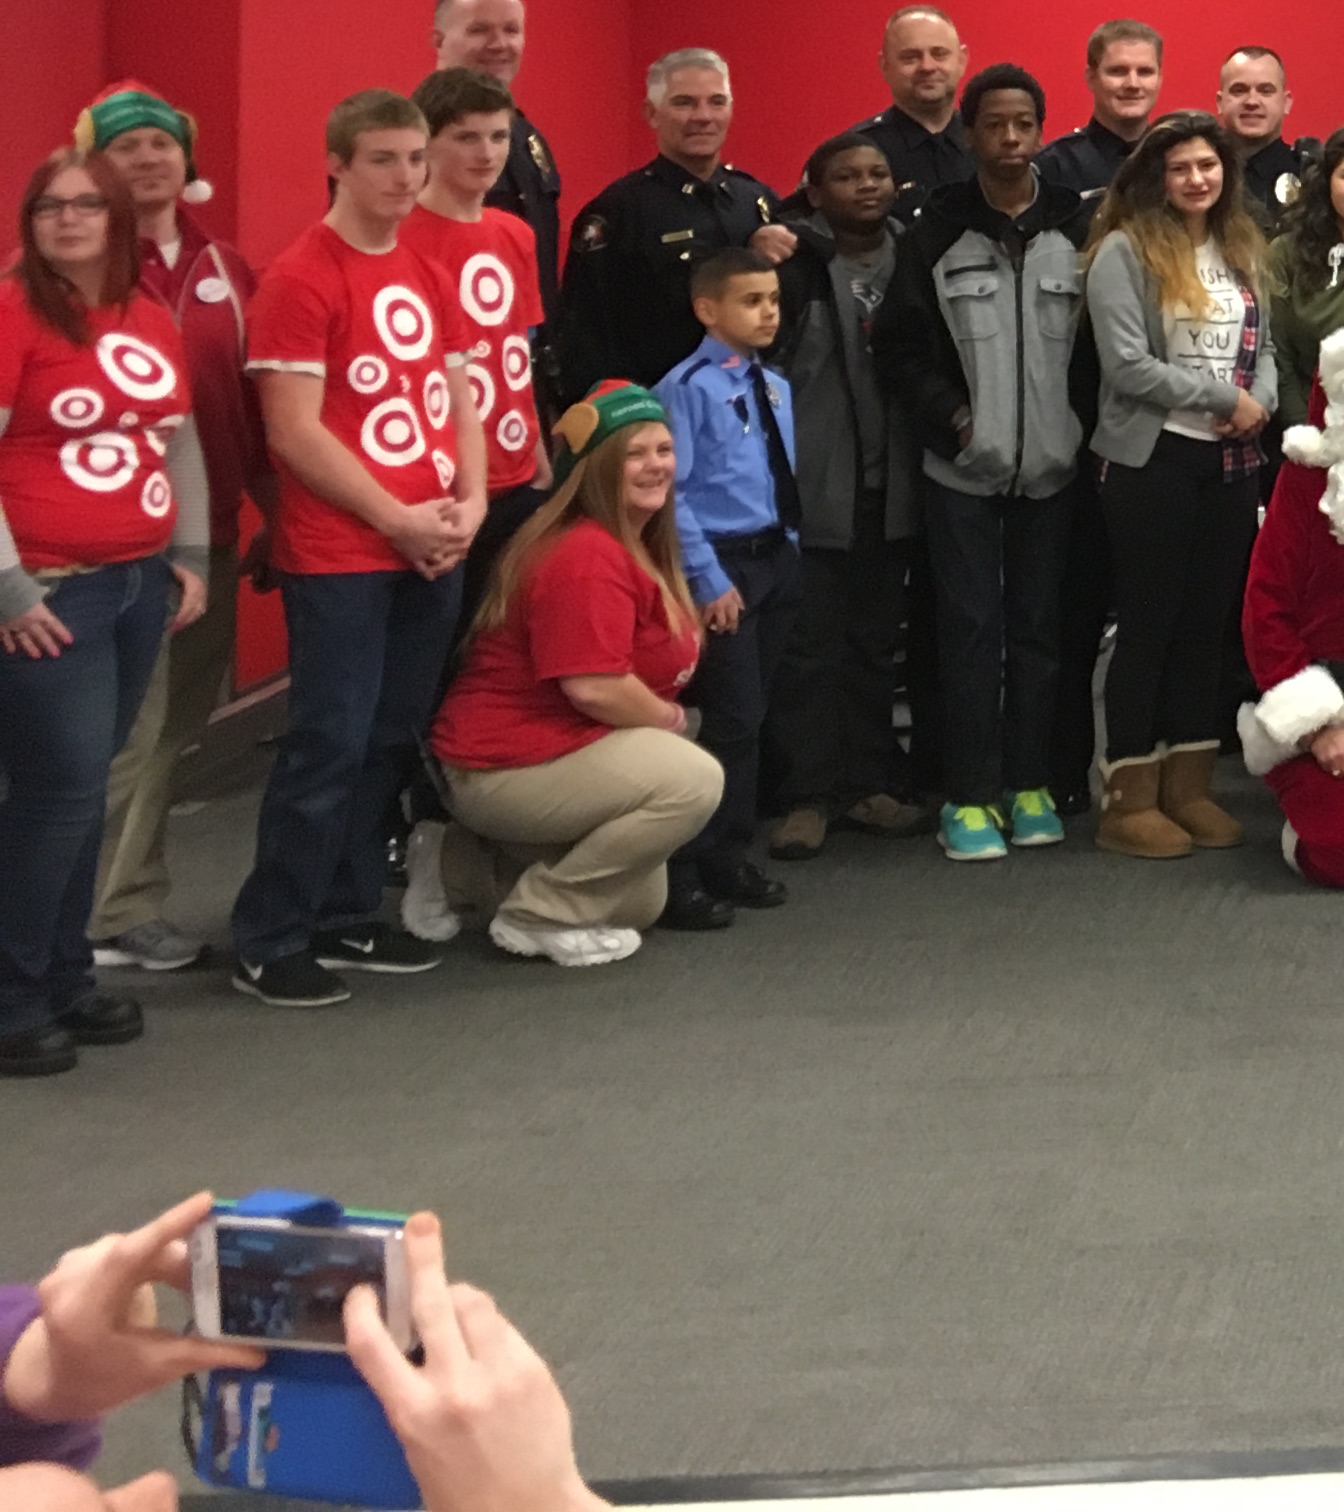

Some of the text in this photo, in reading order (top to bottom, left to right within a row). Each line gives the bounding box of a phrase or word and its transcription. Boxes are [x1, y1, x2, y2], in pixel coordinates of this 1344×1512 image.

[1200, 268, 1230, 286] ISH
[1211, 297, 1234, 316] AT
[1188, 328, 1231, 350] YOU
